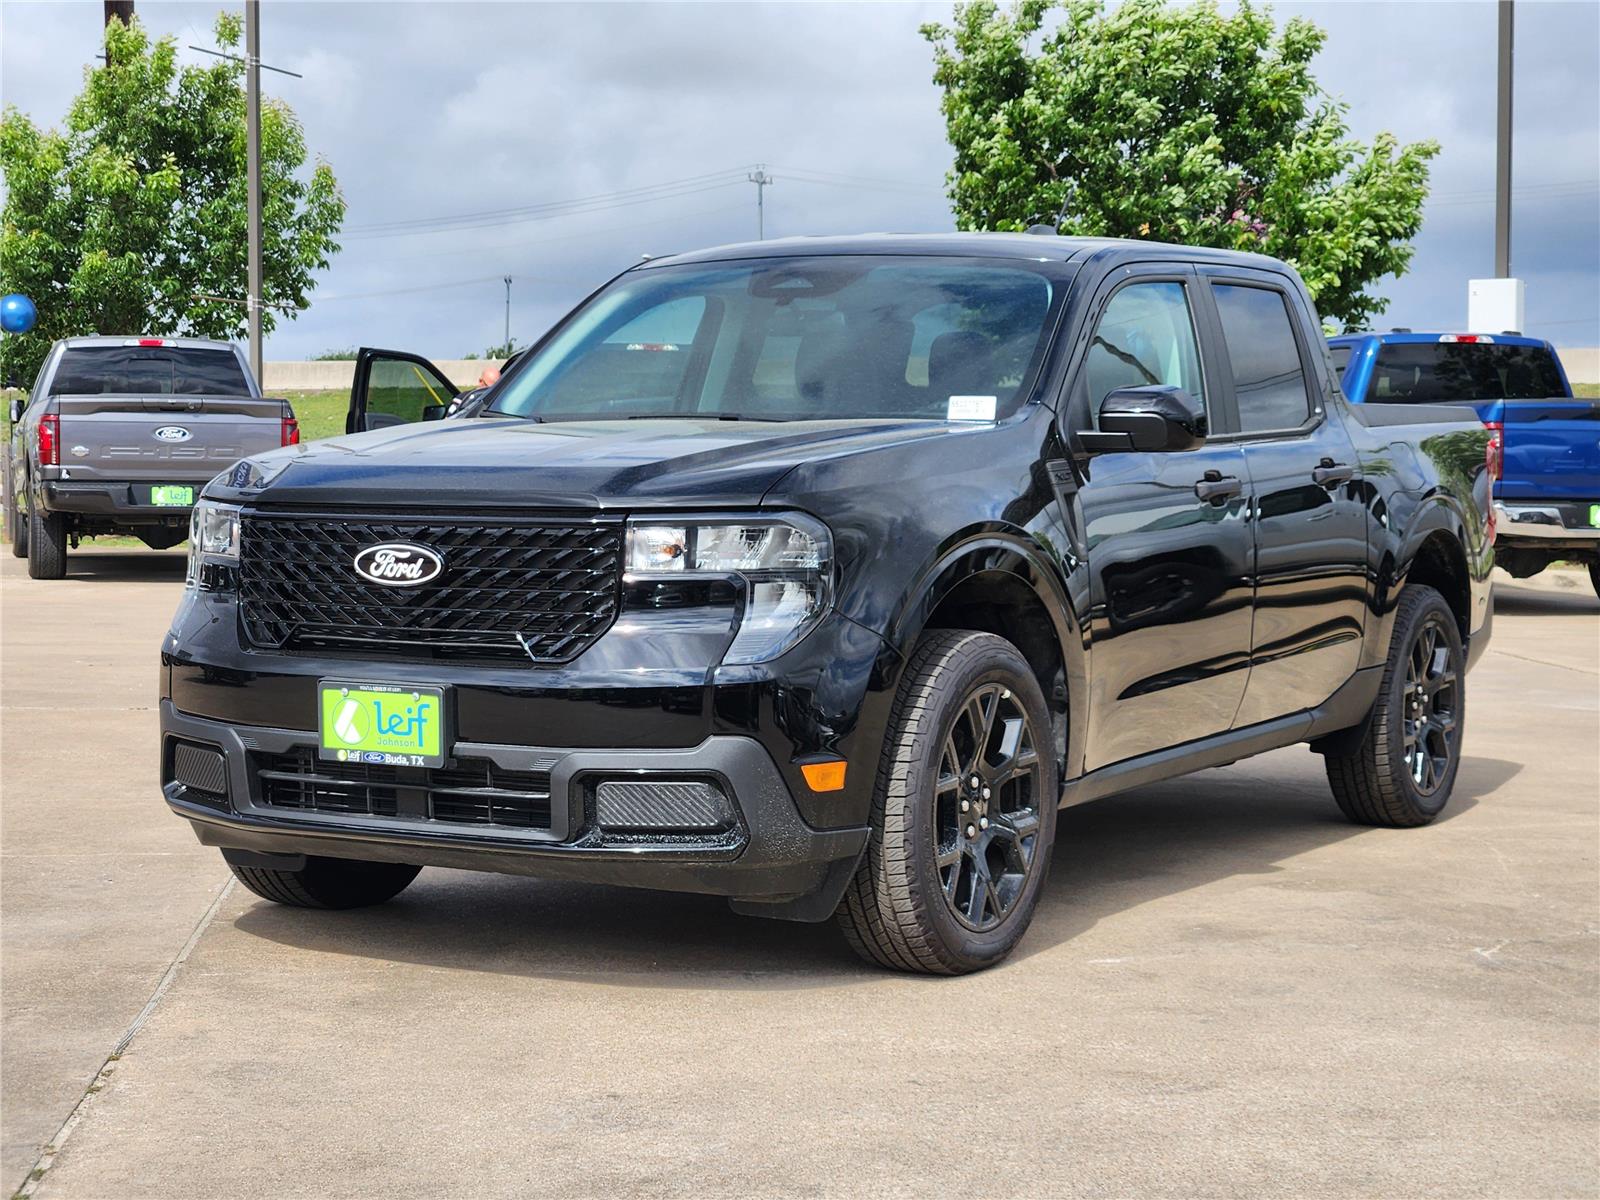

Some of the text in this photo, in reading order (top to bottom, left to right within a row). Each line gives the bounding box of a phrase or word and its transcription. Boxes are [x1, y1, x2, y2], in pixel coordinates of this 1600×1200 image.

[161, 429, 184, 439] Ford
[369, 549, 425, 579] Ford
[373, 700, 431, 748] leif
[377, 737, 415, 748] Johnson
[385, 753, 409, 766] Buda,
[410, 755, 425, 766] TX
